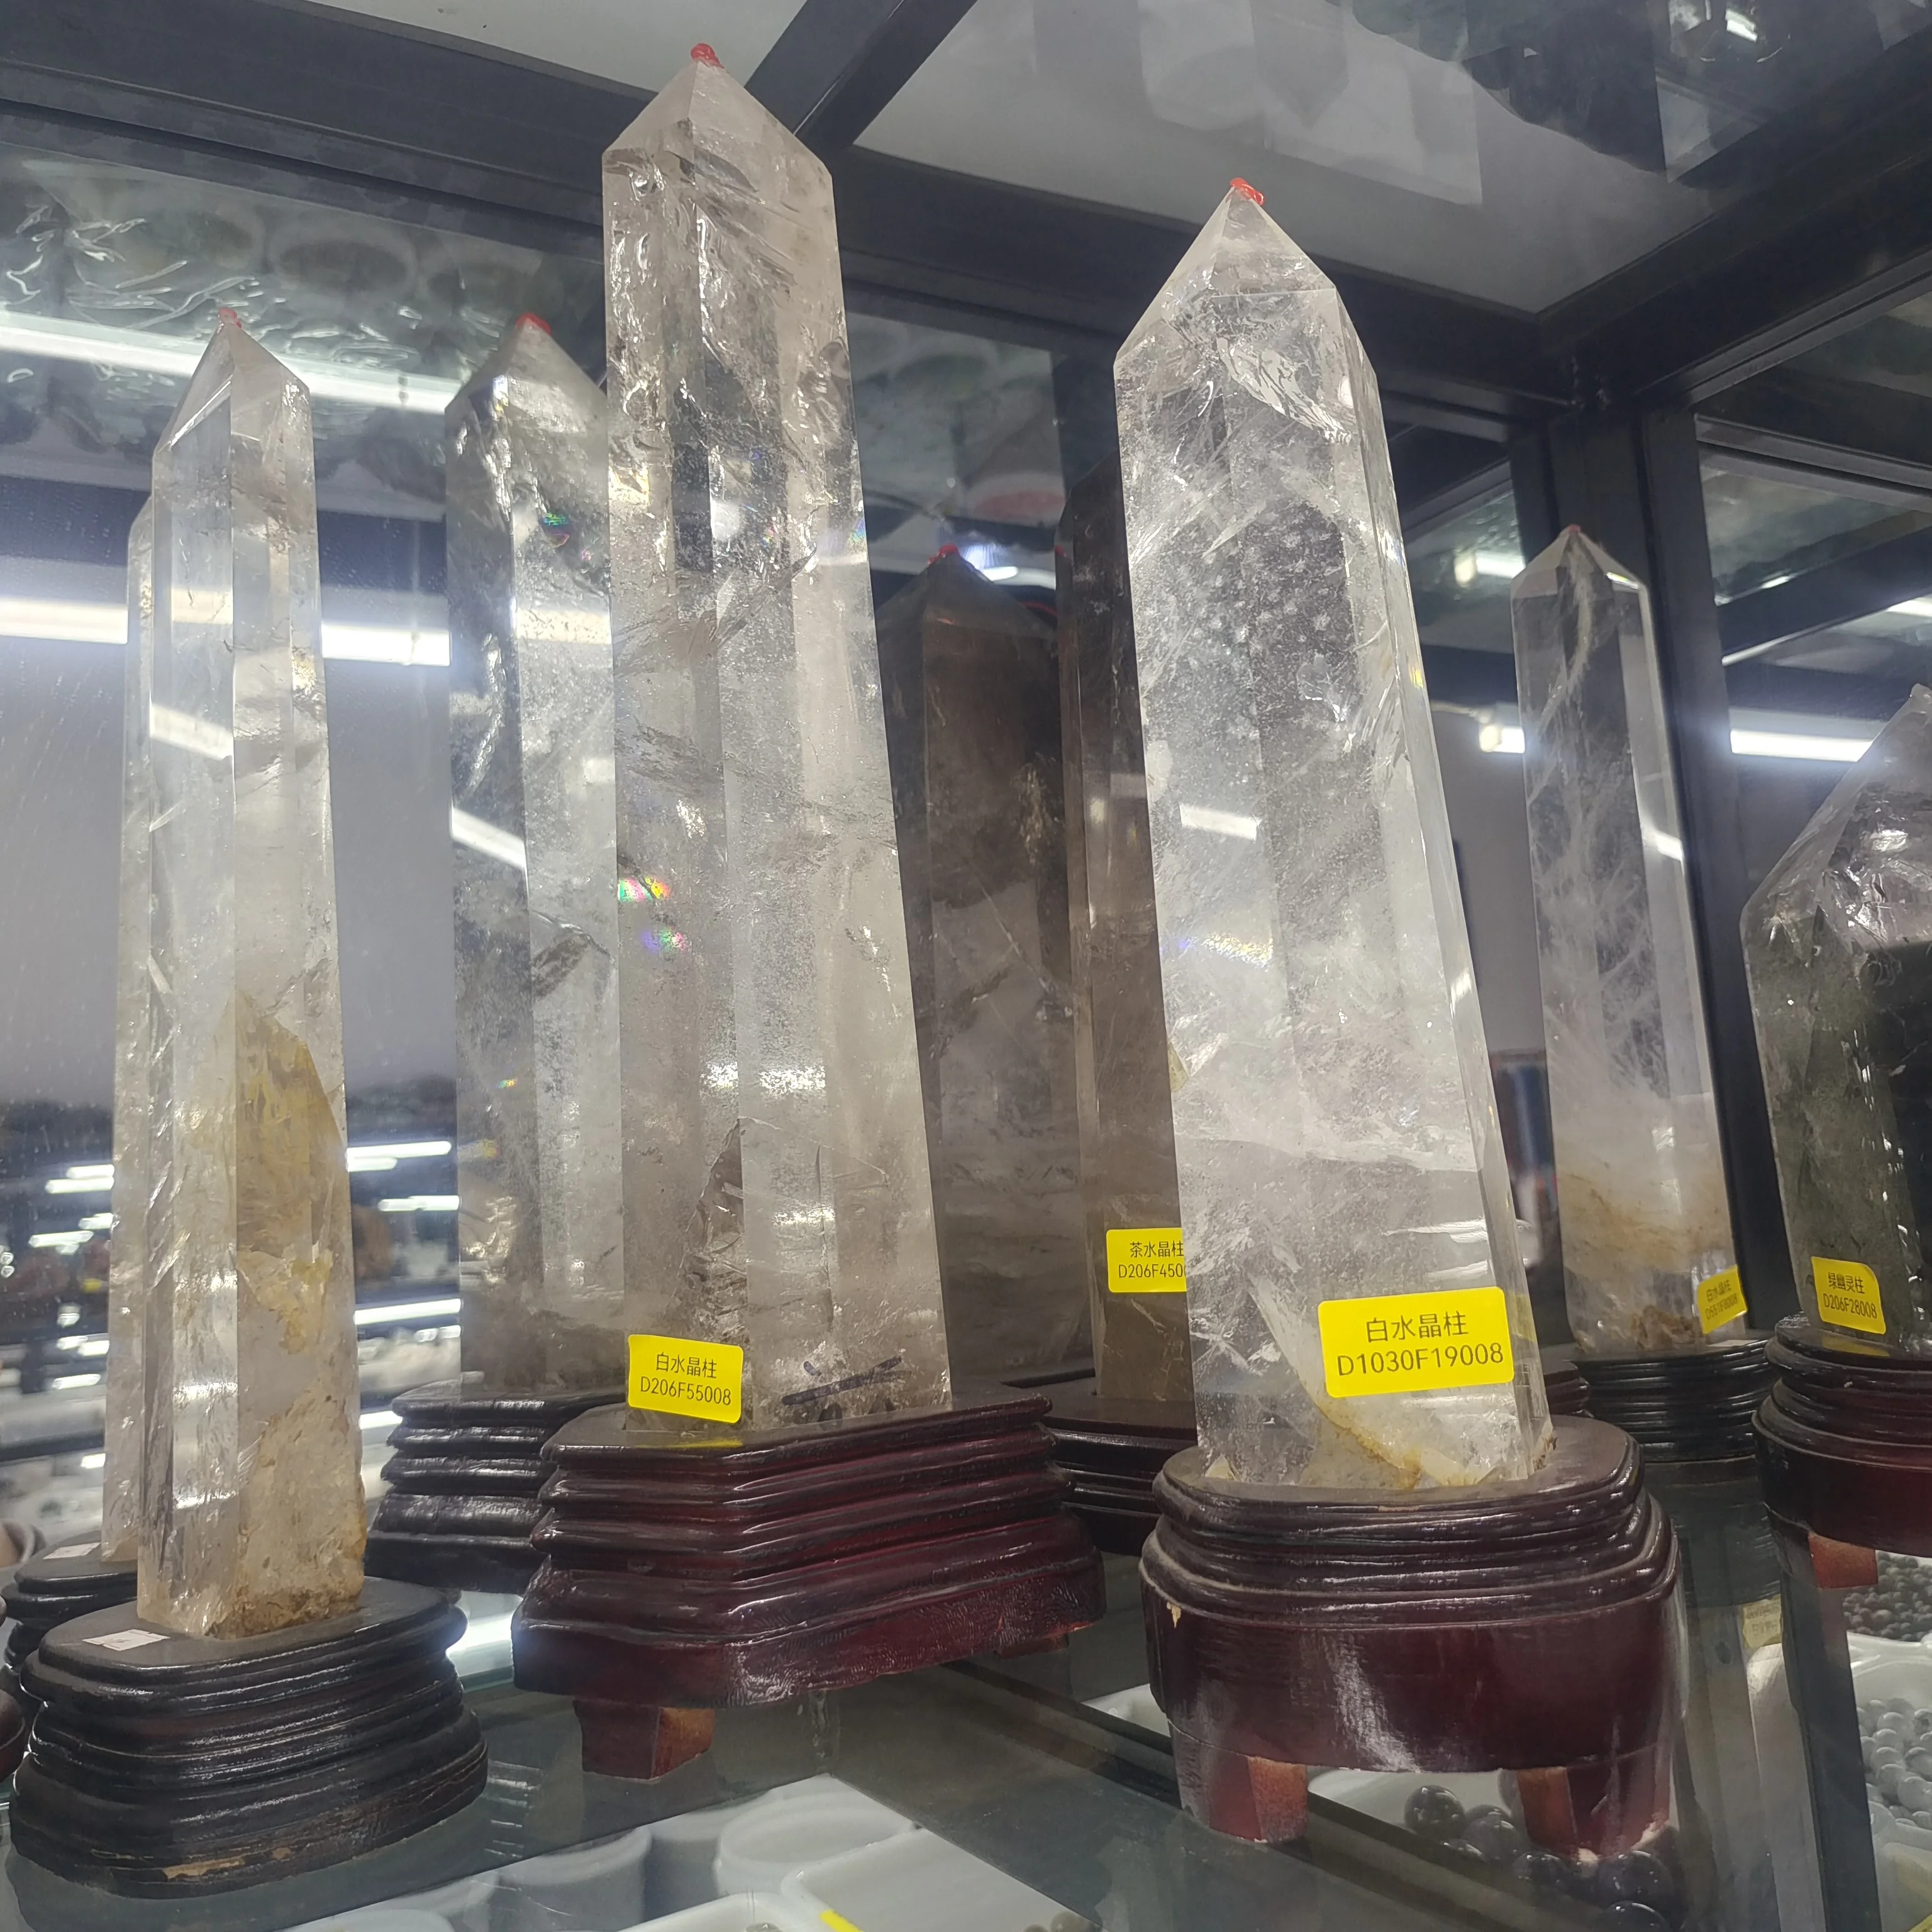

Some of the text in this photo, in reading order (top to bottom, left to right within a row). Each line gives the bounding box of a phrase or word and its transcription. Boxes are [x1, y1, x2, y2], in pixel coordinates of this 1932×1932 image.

[1130, 1240, 1184, 1258] 茶水晶柱
[1118, 1263, 1186, 1279] D206F450
[1823, 1293, 1877, 1319] D206F28008
[1365, 1310, 1469, 1343] 白水晶柱
[656, 1352, 718, 1379] 白水晶柱
[1337, 1342, 1504, 1376] D1030F19008
[640, 1376, 731, 1406] D206F55008
